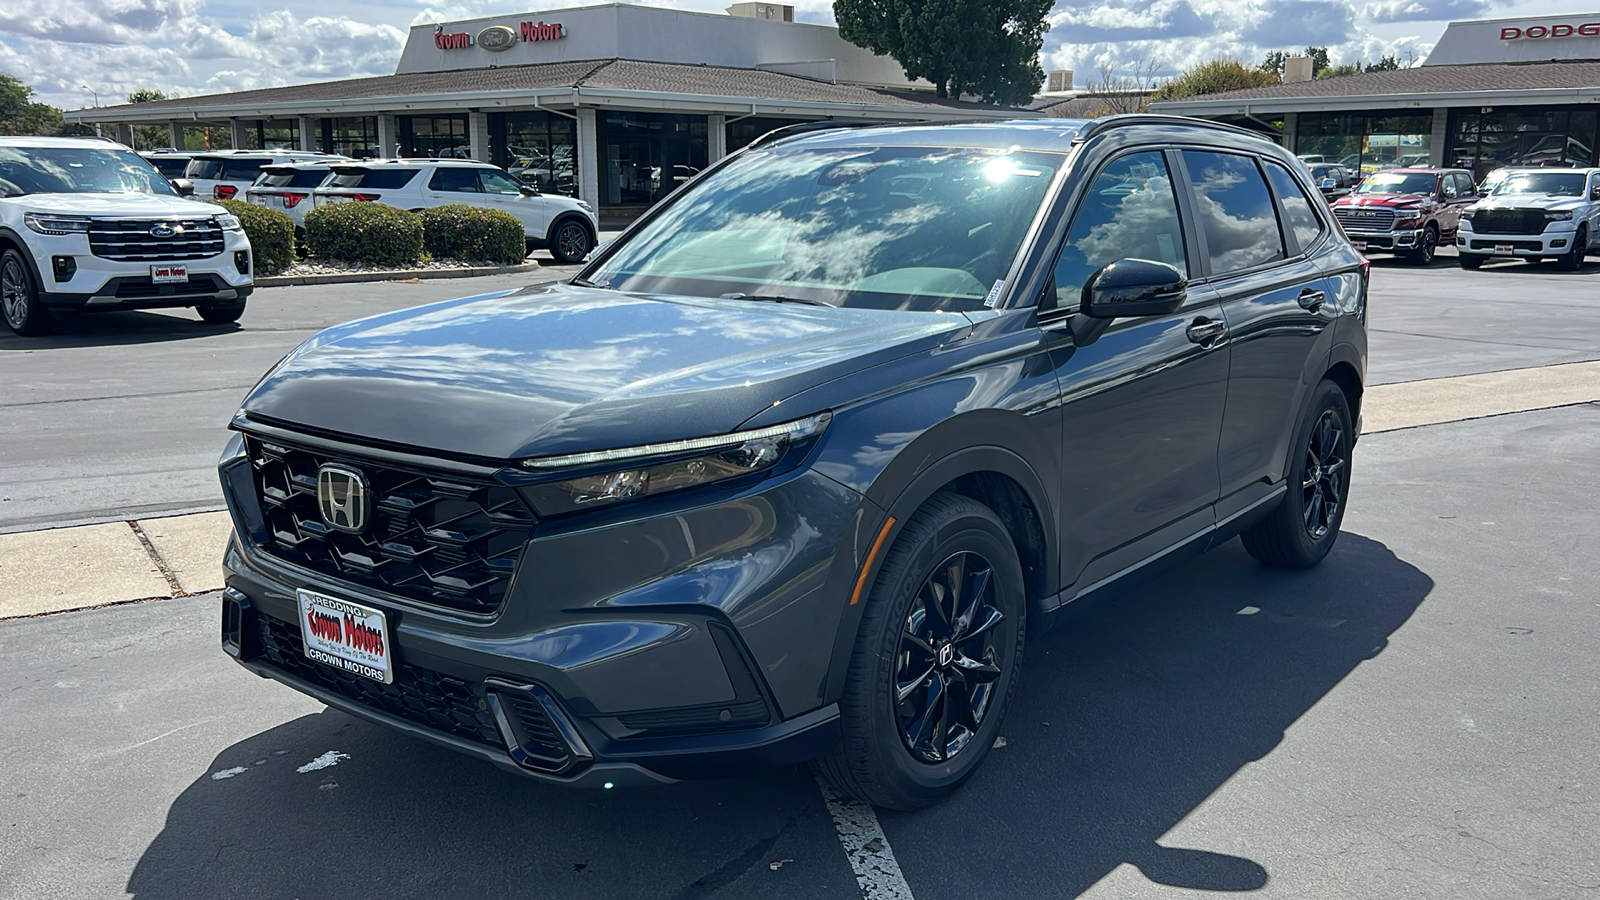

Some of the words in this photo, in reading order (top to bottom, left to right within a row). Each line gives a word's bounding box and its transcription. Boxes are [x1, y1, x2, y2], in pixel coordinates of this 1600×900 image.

[434, 26, 470, 50] Crown
[520, 20, 564, 43] Motors
[484, 31, 503, 46] Ford
[315, 596, 362, 617] REDDING
[307, 607, 343, 644] Crown
[343, 612, 384, 657] Motors
[309, 648, 343, 668] CROWN
[344, 660, 384, 681] MOTORS
